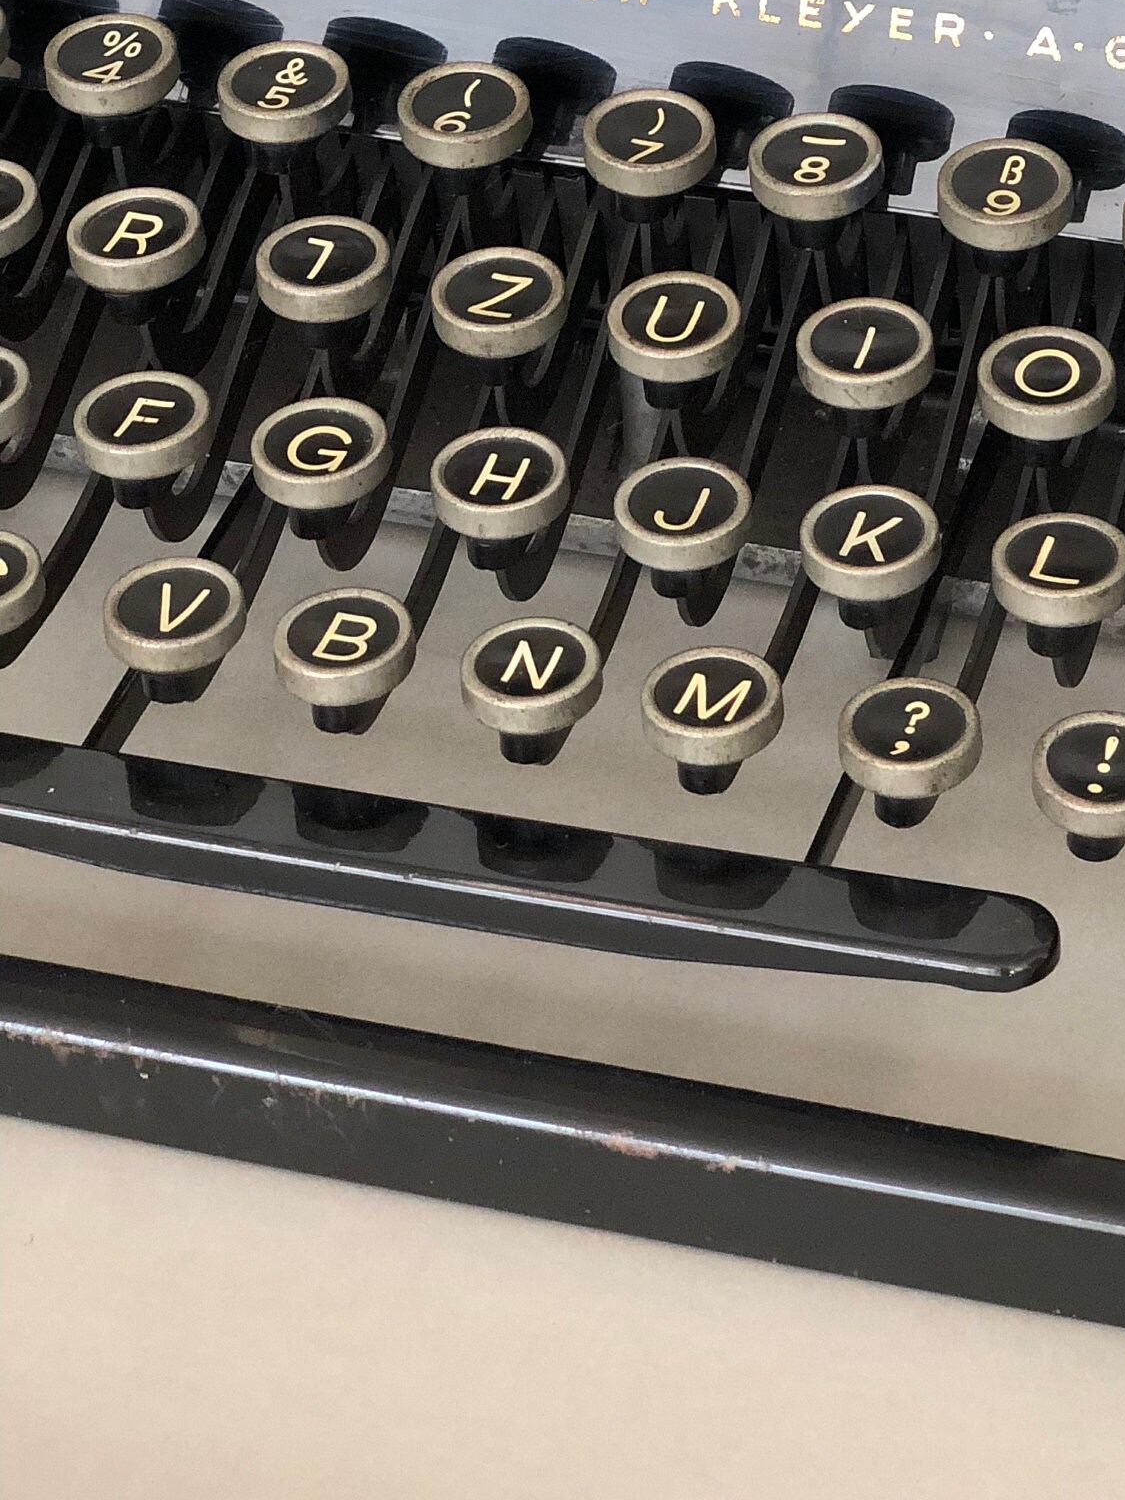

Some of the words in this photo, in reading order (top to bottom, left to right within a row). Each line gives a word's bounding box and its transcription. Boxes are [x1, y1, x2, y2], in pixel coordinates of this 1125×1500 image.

[103, 30, 142, 59] %
[82, 60, 123, 84] 4
[276, 58, 308, 86] &
[257, 86, 297, 110] 5
[433, 111, 471, 133] 6
[628, 138, 664, 163] 7
[793, 156, 830, 183] 8
[982, 190, 1021, 216] 9
[103, 212, 164, 256] R
[467, 272, 534, 319] Z
[646, 295, 705, 343] U
[1014, 348, 1081, 397] O
[113, 397, 175, 438] F
[287, 425, 352, 472] G
[469, 453, 532, 500] H
[653, 487, 710, 531] J
[838, 511, 904, 563] K
[1029, 535, 1080, 586] L
[160, 582, 210, 633] V
[312, 612, 378, 662] B
[500, 639, 565, 690] N
[673, 672, 753, 722] M
